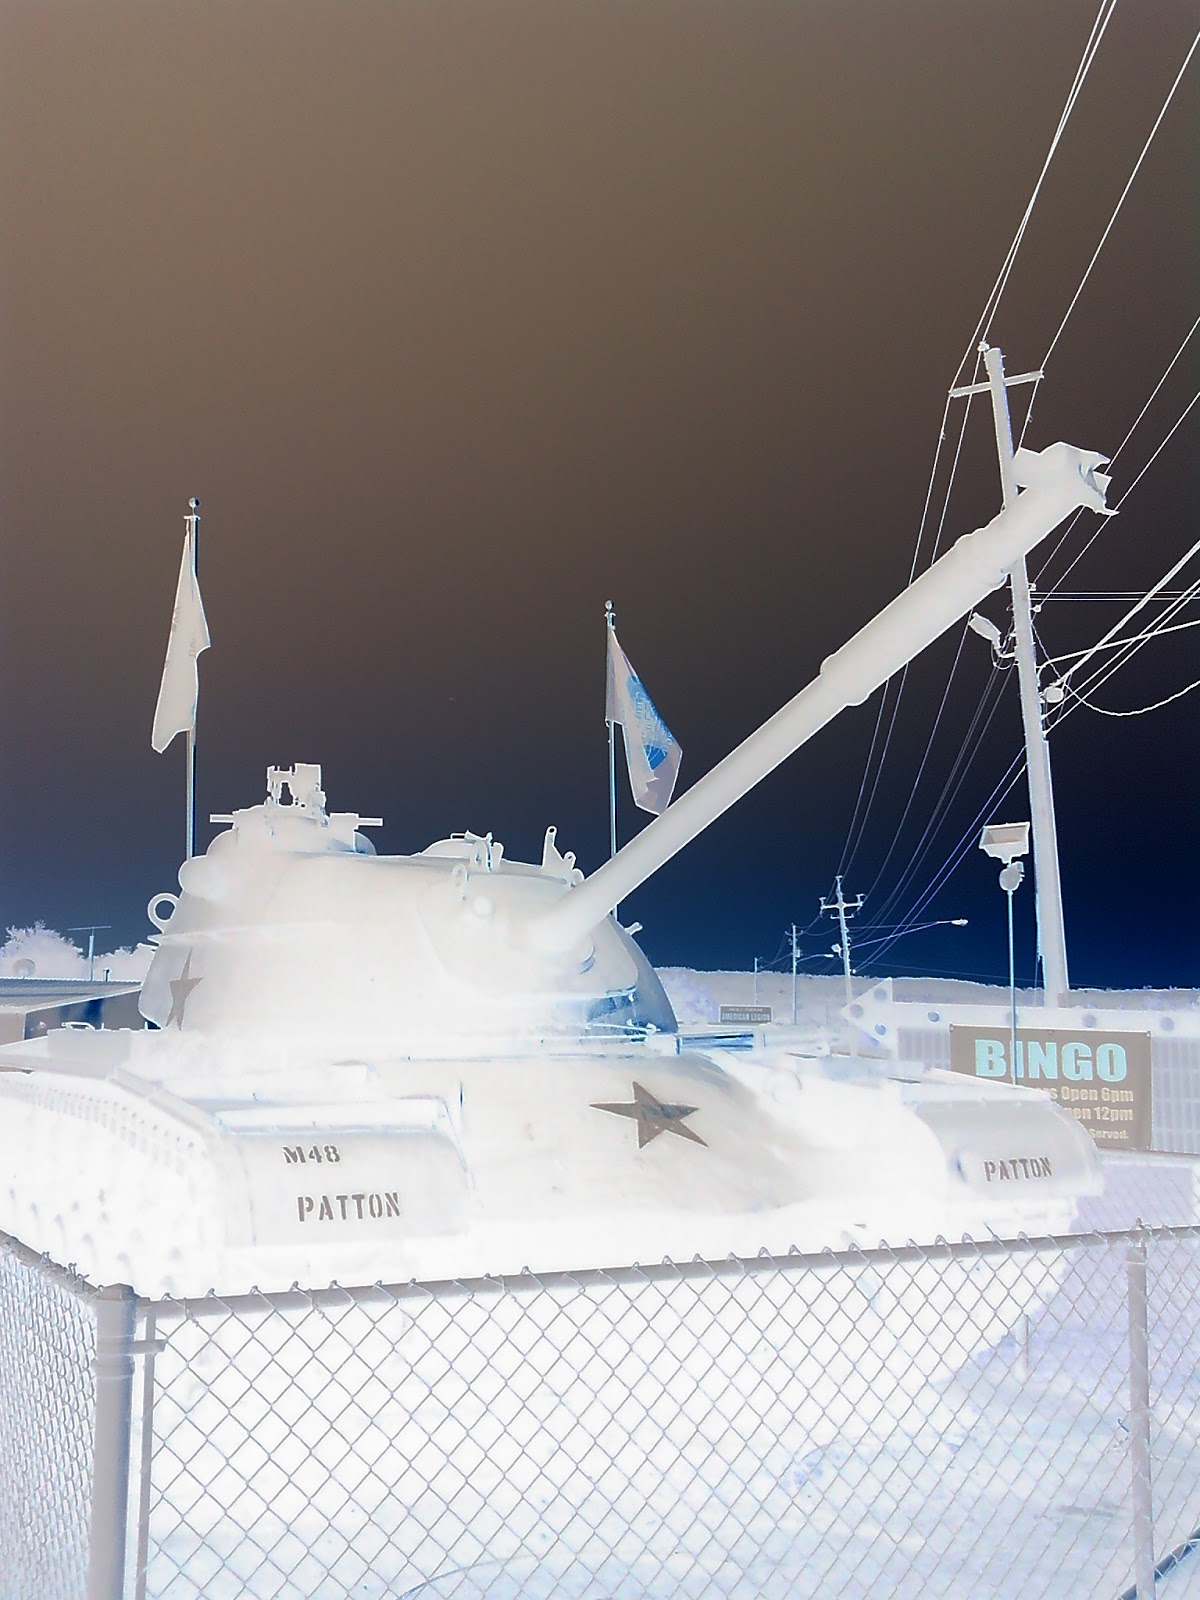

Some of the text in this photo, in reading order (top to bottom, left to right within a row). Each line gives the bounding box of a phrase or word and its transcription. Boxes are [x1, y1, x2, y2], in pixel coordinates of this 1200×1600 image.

[974, 1039, 1128, 1083] BINGO
[1060, 1086, 1098, 1101] Open
[1101, 1087, 1134, 1103] 6pm
[1094, 1106, 1134, 1121] 12pm
[282, 1145, 341, 1163] M48
[983, 1156, 1053, 1182] PATTON
[297, 1192, 401, 1222] PATTON
